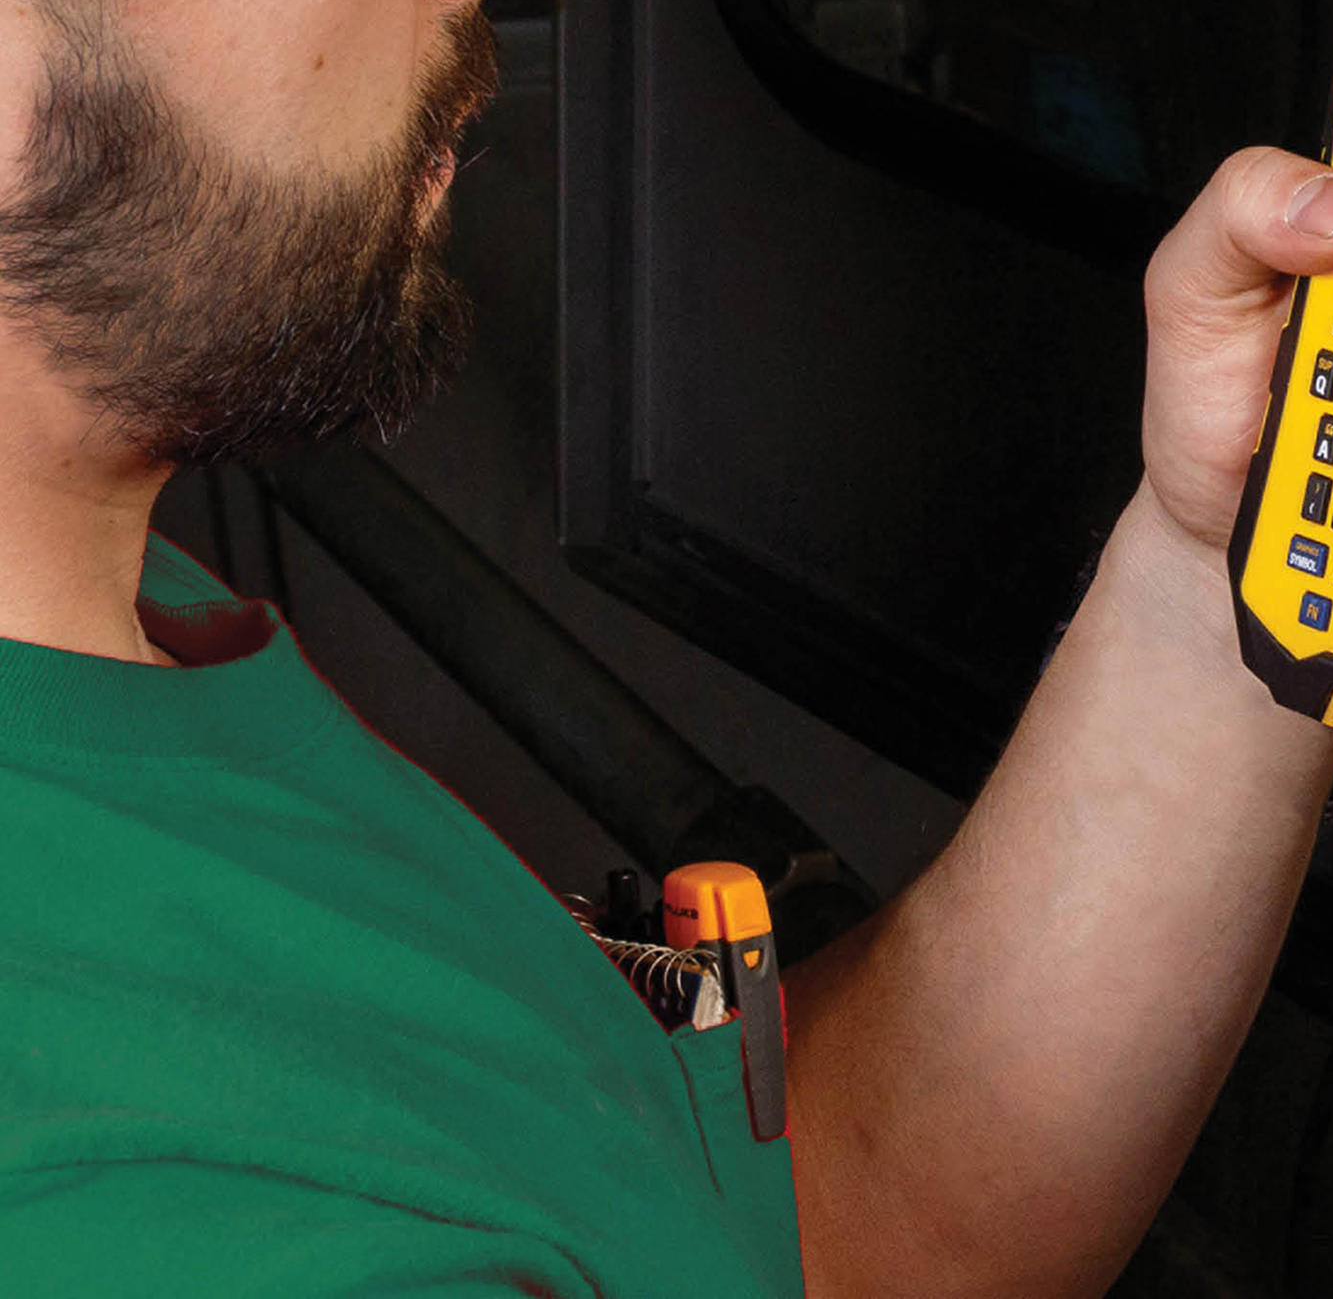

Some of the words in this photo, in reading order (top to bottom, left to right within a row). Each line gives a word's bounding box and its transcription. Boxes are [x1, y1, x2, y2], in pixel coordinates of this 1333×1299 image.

[1315, 375, 1327, 395] Q
[1316, 441, 1329, 460] A
[1289, 552, 1317, 573] SYMBOL
